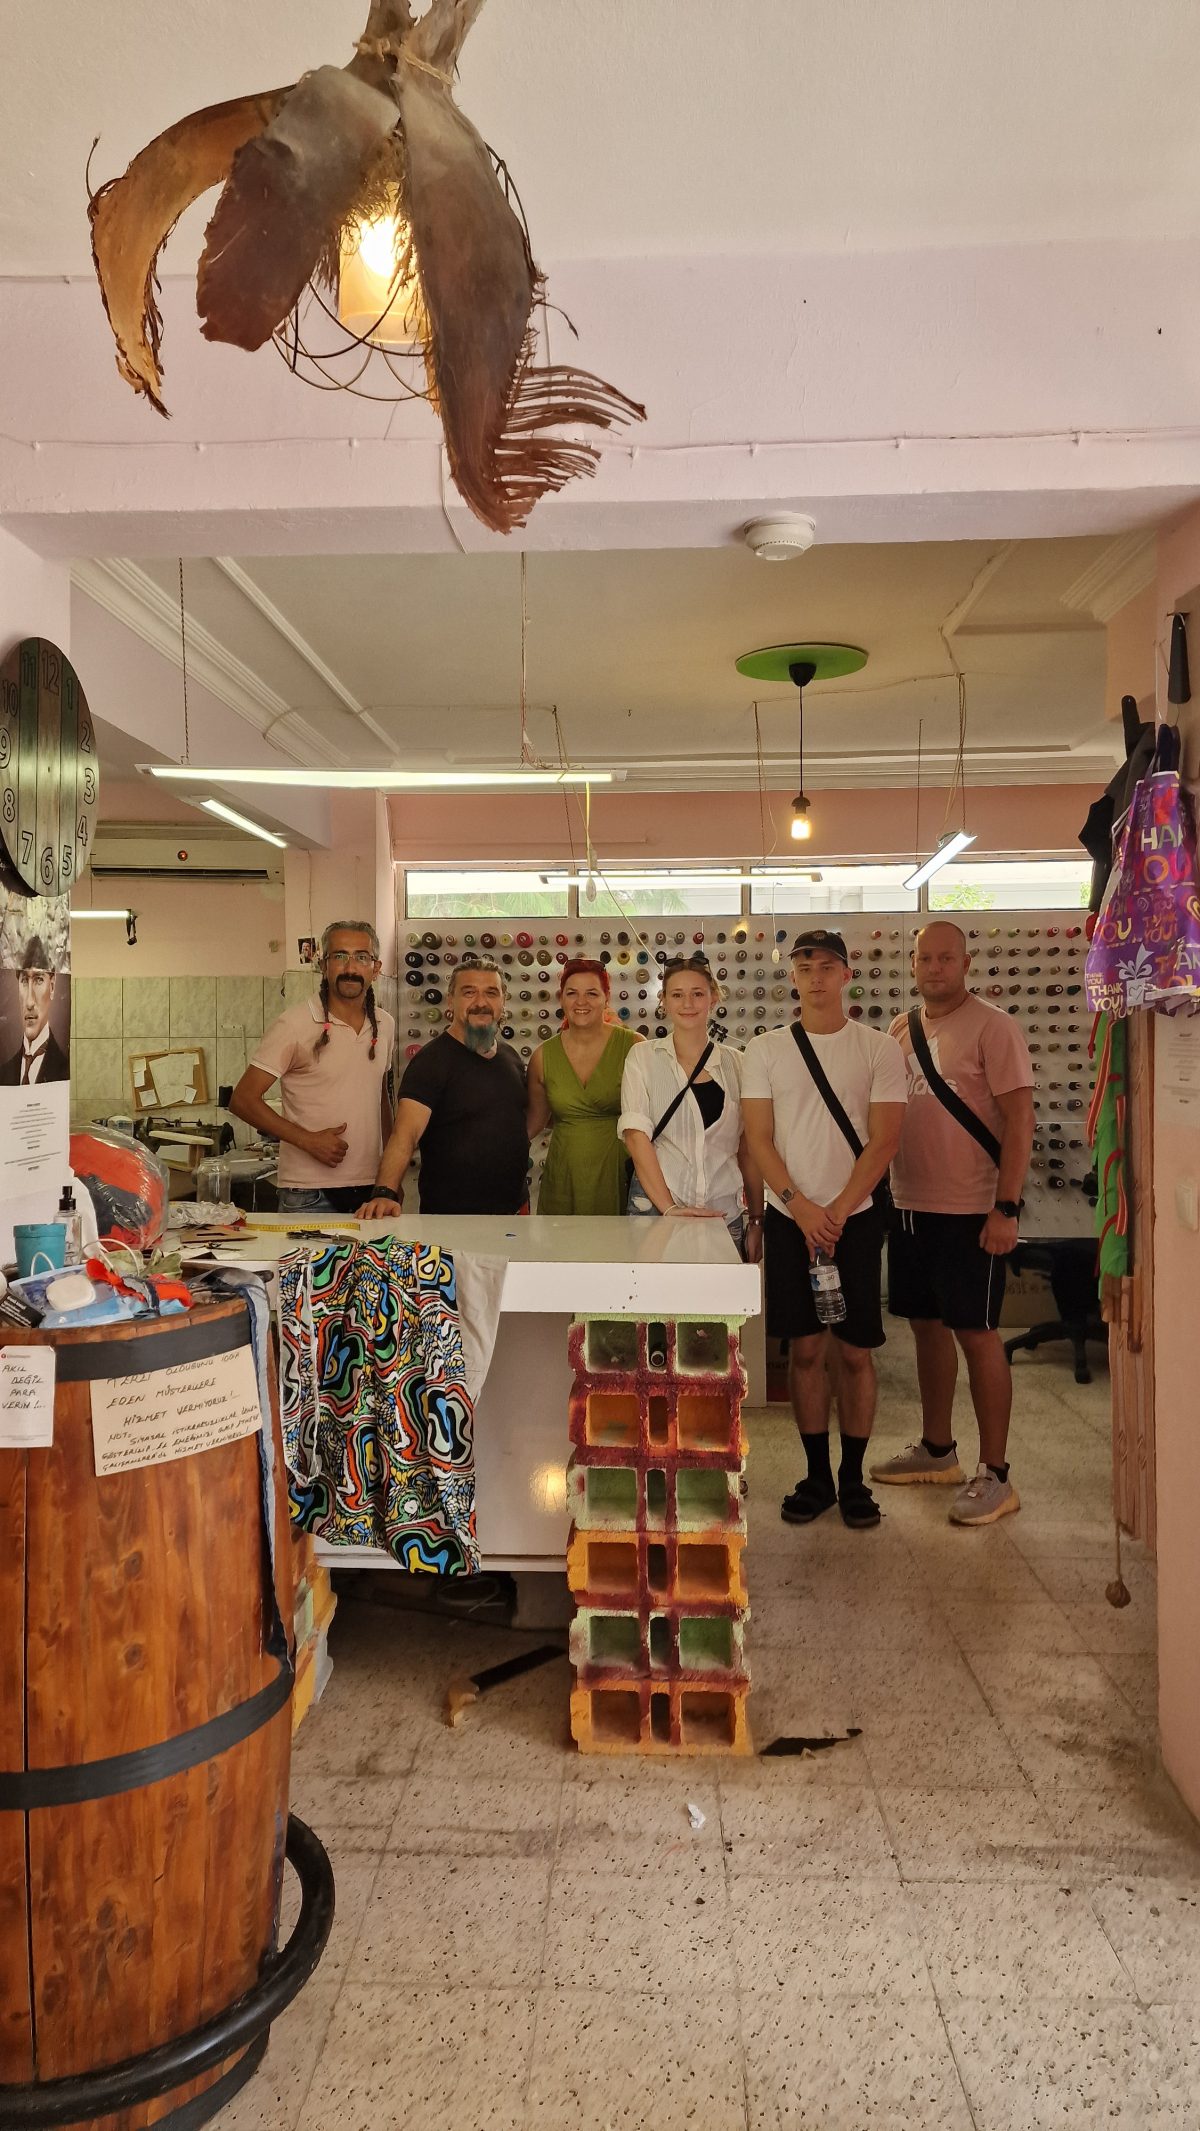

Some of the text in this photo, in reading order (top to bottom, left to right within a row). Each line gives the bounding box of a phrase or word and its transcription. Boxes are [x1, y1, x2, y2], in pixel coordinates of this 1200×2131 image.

[23, 651, 36, 689] 11
[42, 649, 60, 696] 12
[2, 679, 18, 717] 10
[67, 679, 74, 710] 1
[0, 728, 11, 769] 9
[80, 721, 91, 753] 2
[84, 767, 96, 805] 3
[3, 788, 16, 823] 8
[22, 831, 34, 864] 7
[77, 816, 88, 847] 4
[40, 847, 54, 885] 6
[62, 845, 73, 877] 5
[1088, 982, 1124, 997] THANK
[1092, 995, 1124, 1012] YOU!
[9, 1388, 36, 1397] PARA
[106, 1395, 146, 1409] EDEN
